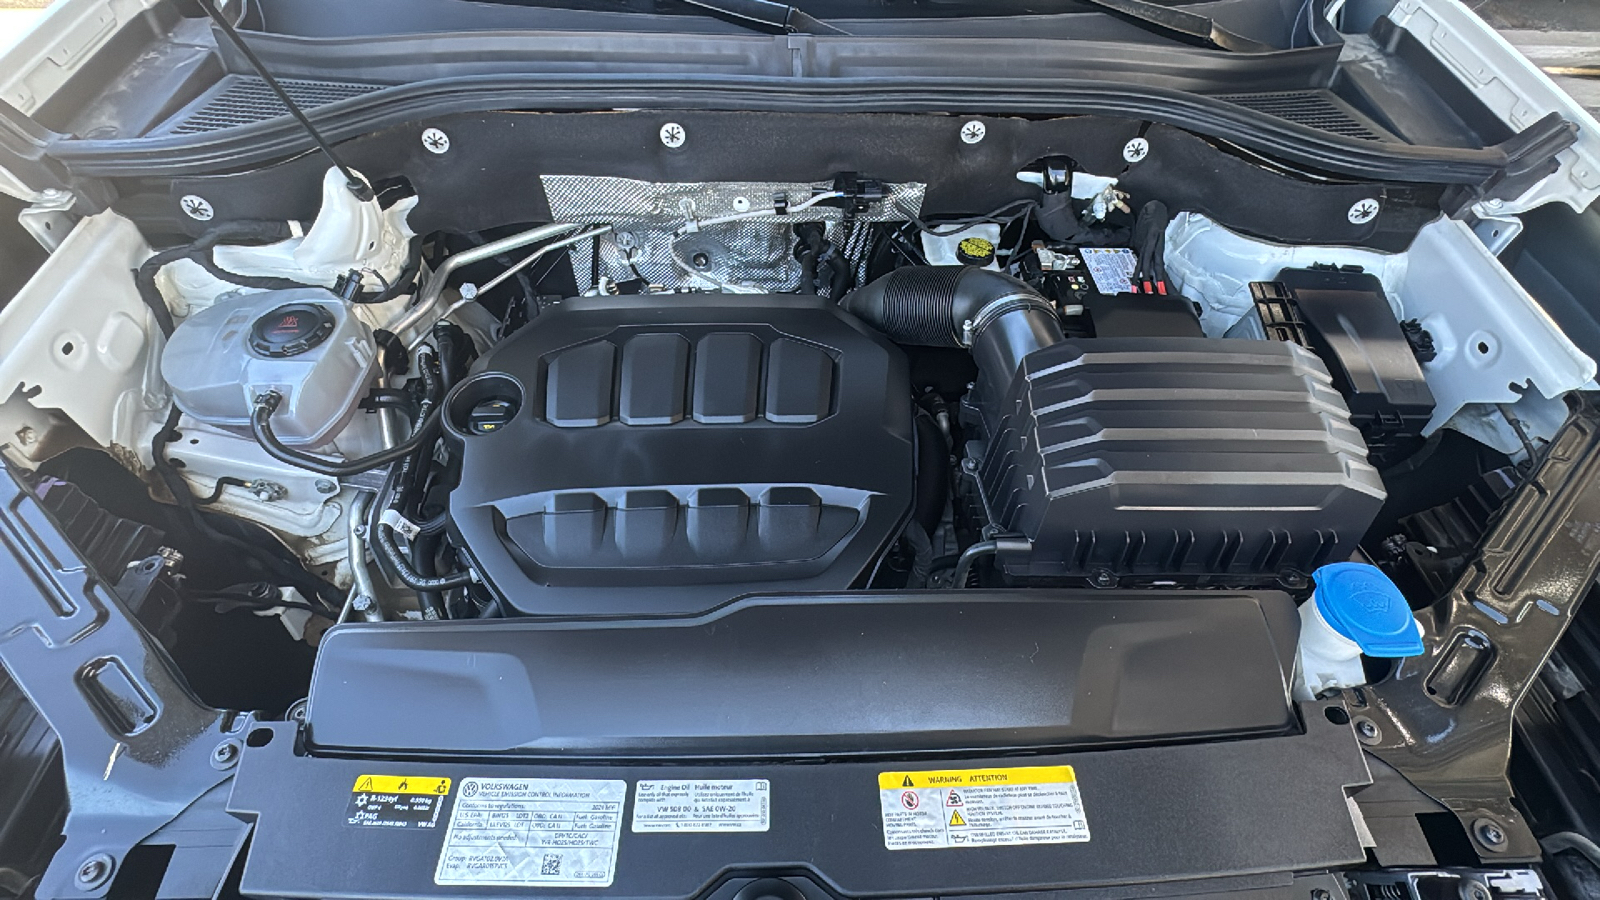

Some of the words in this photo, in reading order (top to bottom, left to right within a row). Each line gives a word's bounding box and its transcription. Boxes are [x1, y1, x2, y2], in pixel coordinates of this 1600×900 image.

[928, 776, 962, 784] WARNING
[969, 774, 1008, 782] ATTENTION
[481, 783, 529, 791] VOLKSWAGEN
[660, 784, 680, 792] Engine
